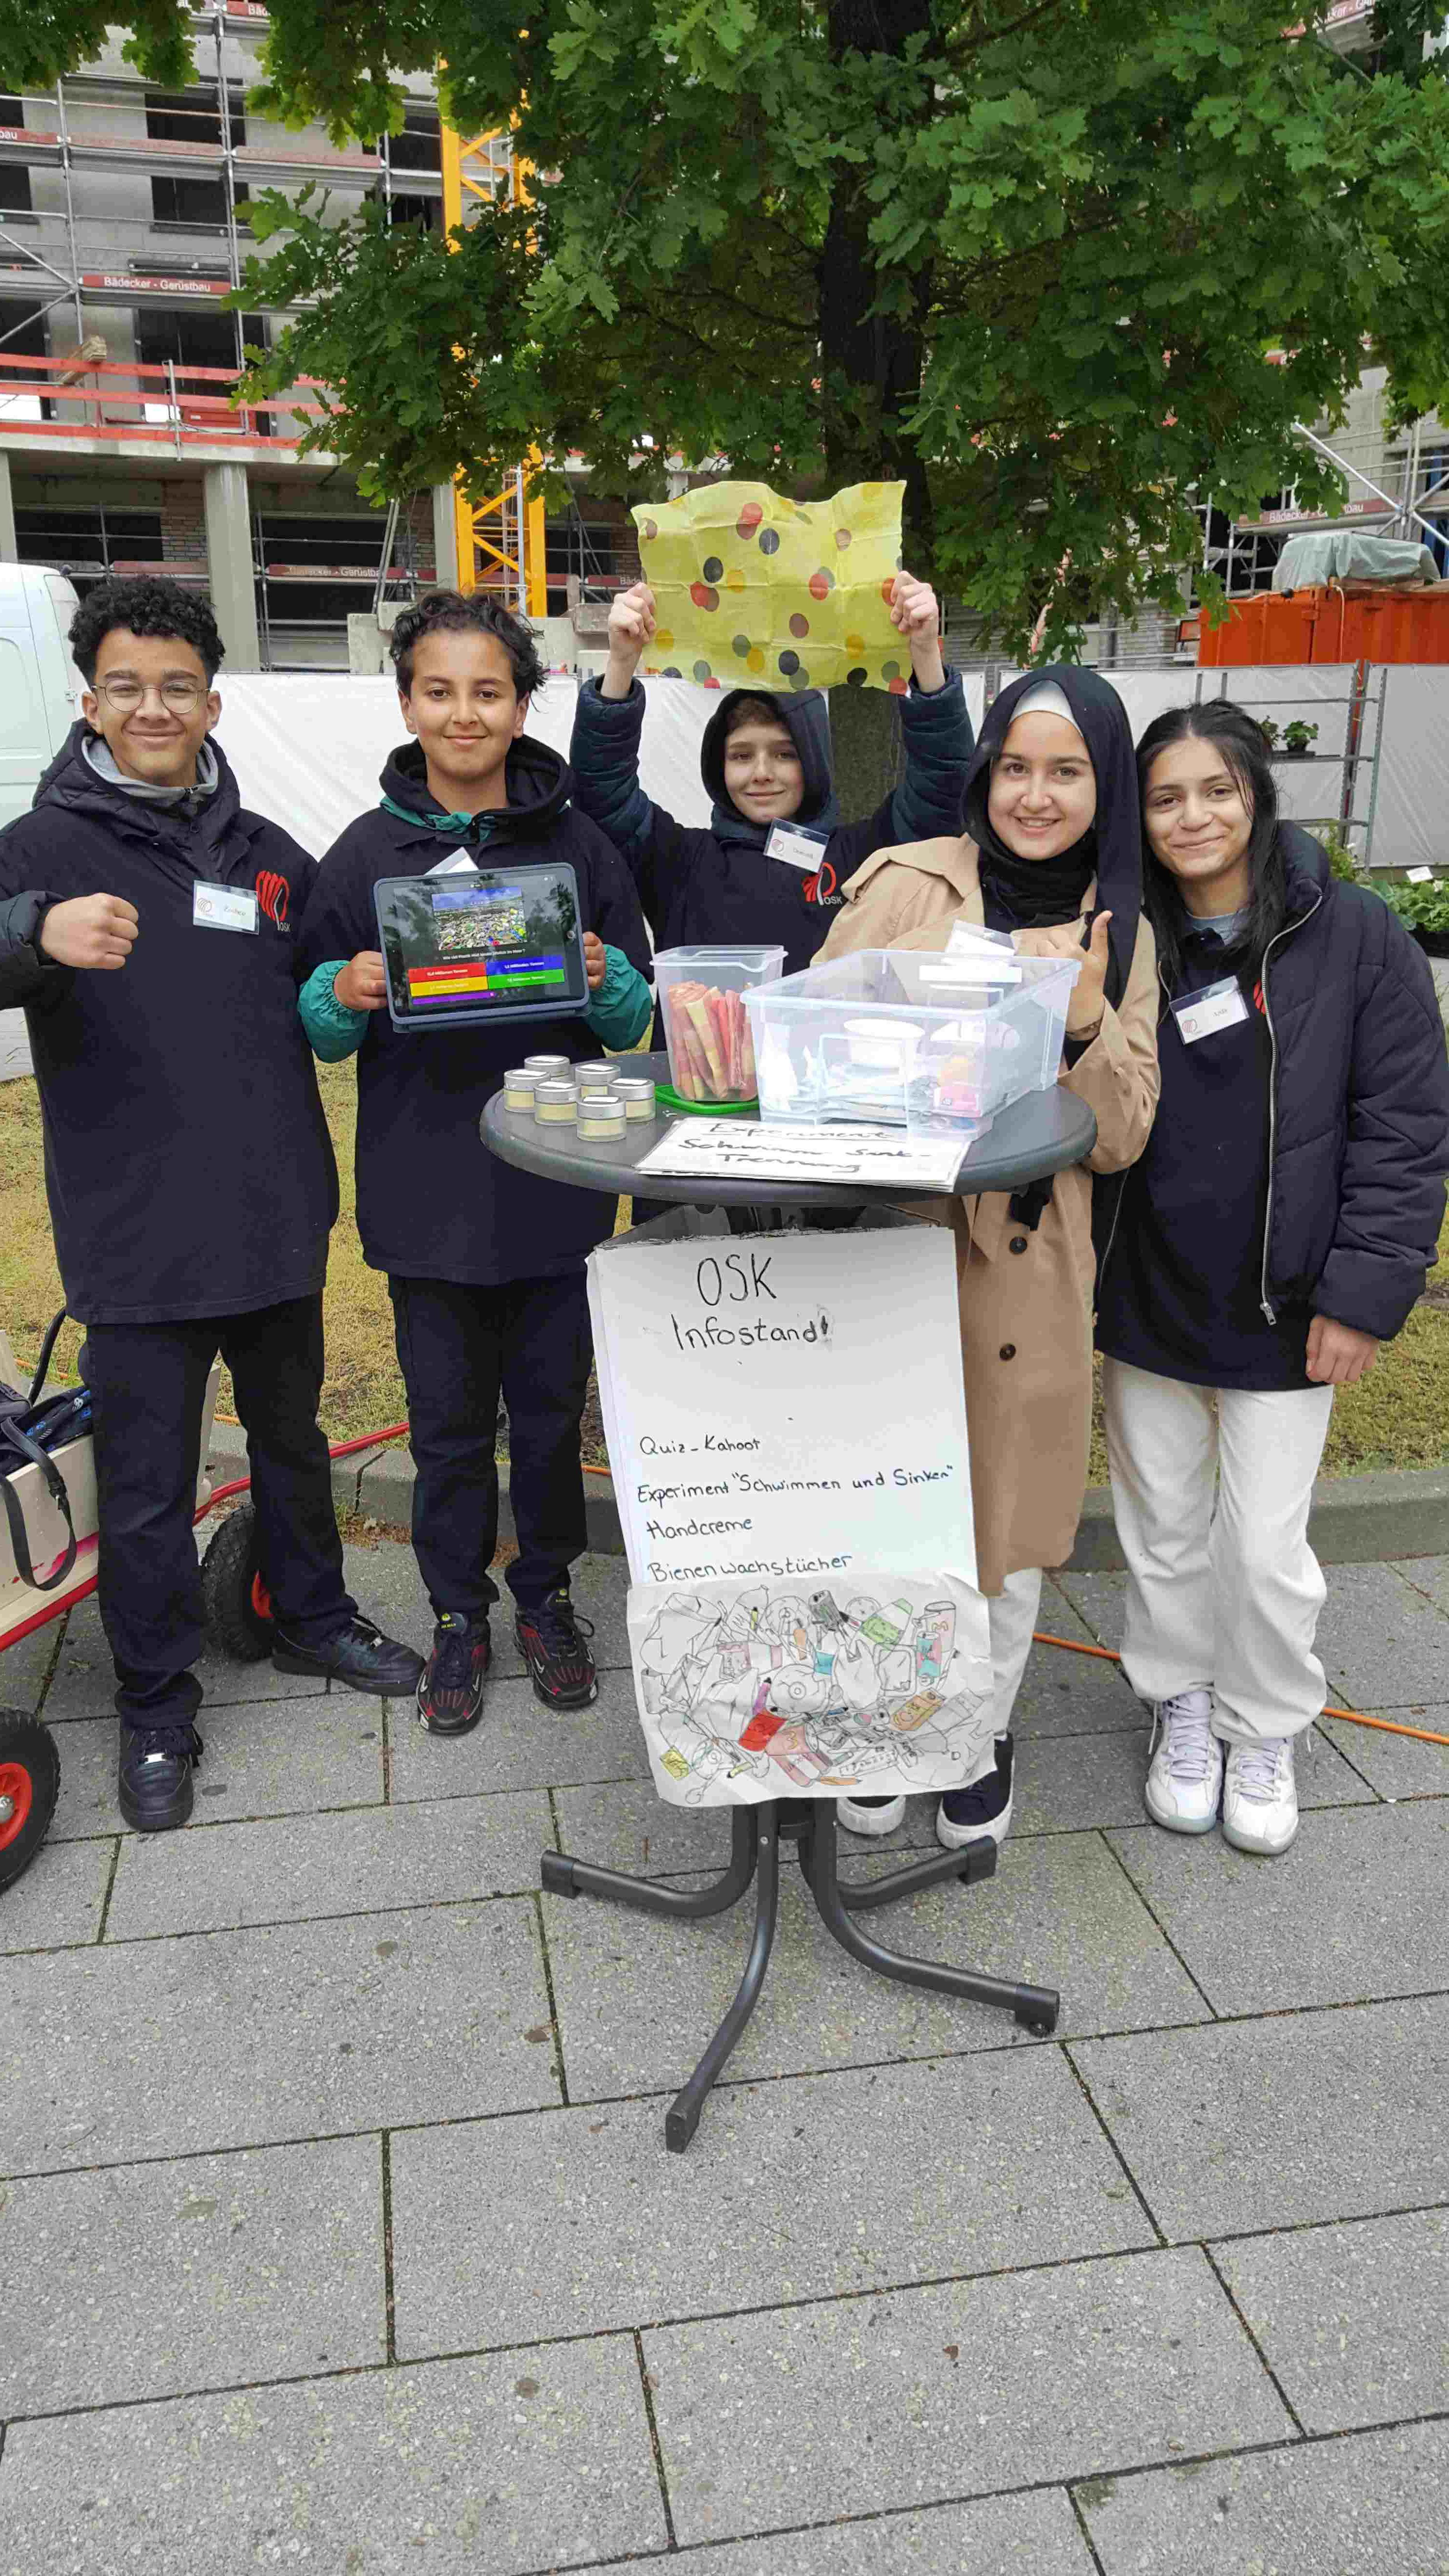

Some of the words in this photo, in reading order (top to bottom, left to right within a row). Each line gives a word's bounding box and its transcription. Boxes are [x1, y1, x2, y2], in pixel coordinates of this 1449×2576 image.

[103, 276, 150, 288] Bädecker
[160, 280, 211, 291] Gerüstbau
[824, 896, 843, 905] OSK
[697, 1254, 777, 1306] OSK
[640, 1436, 685, 1455] Quiz
[705, 1434, 761, 1451] Kahoot
[637, 1481, 728, 1509] Experiment
[853, 1471, 885, 1489] und
[646, 1518, 753, 1540] Handcreme
